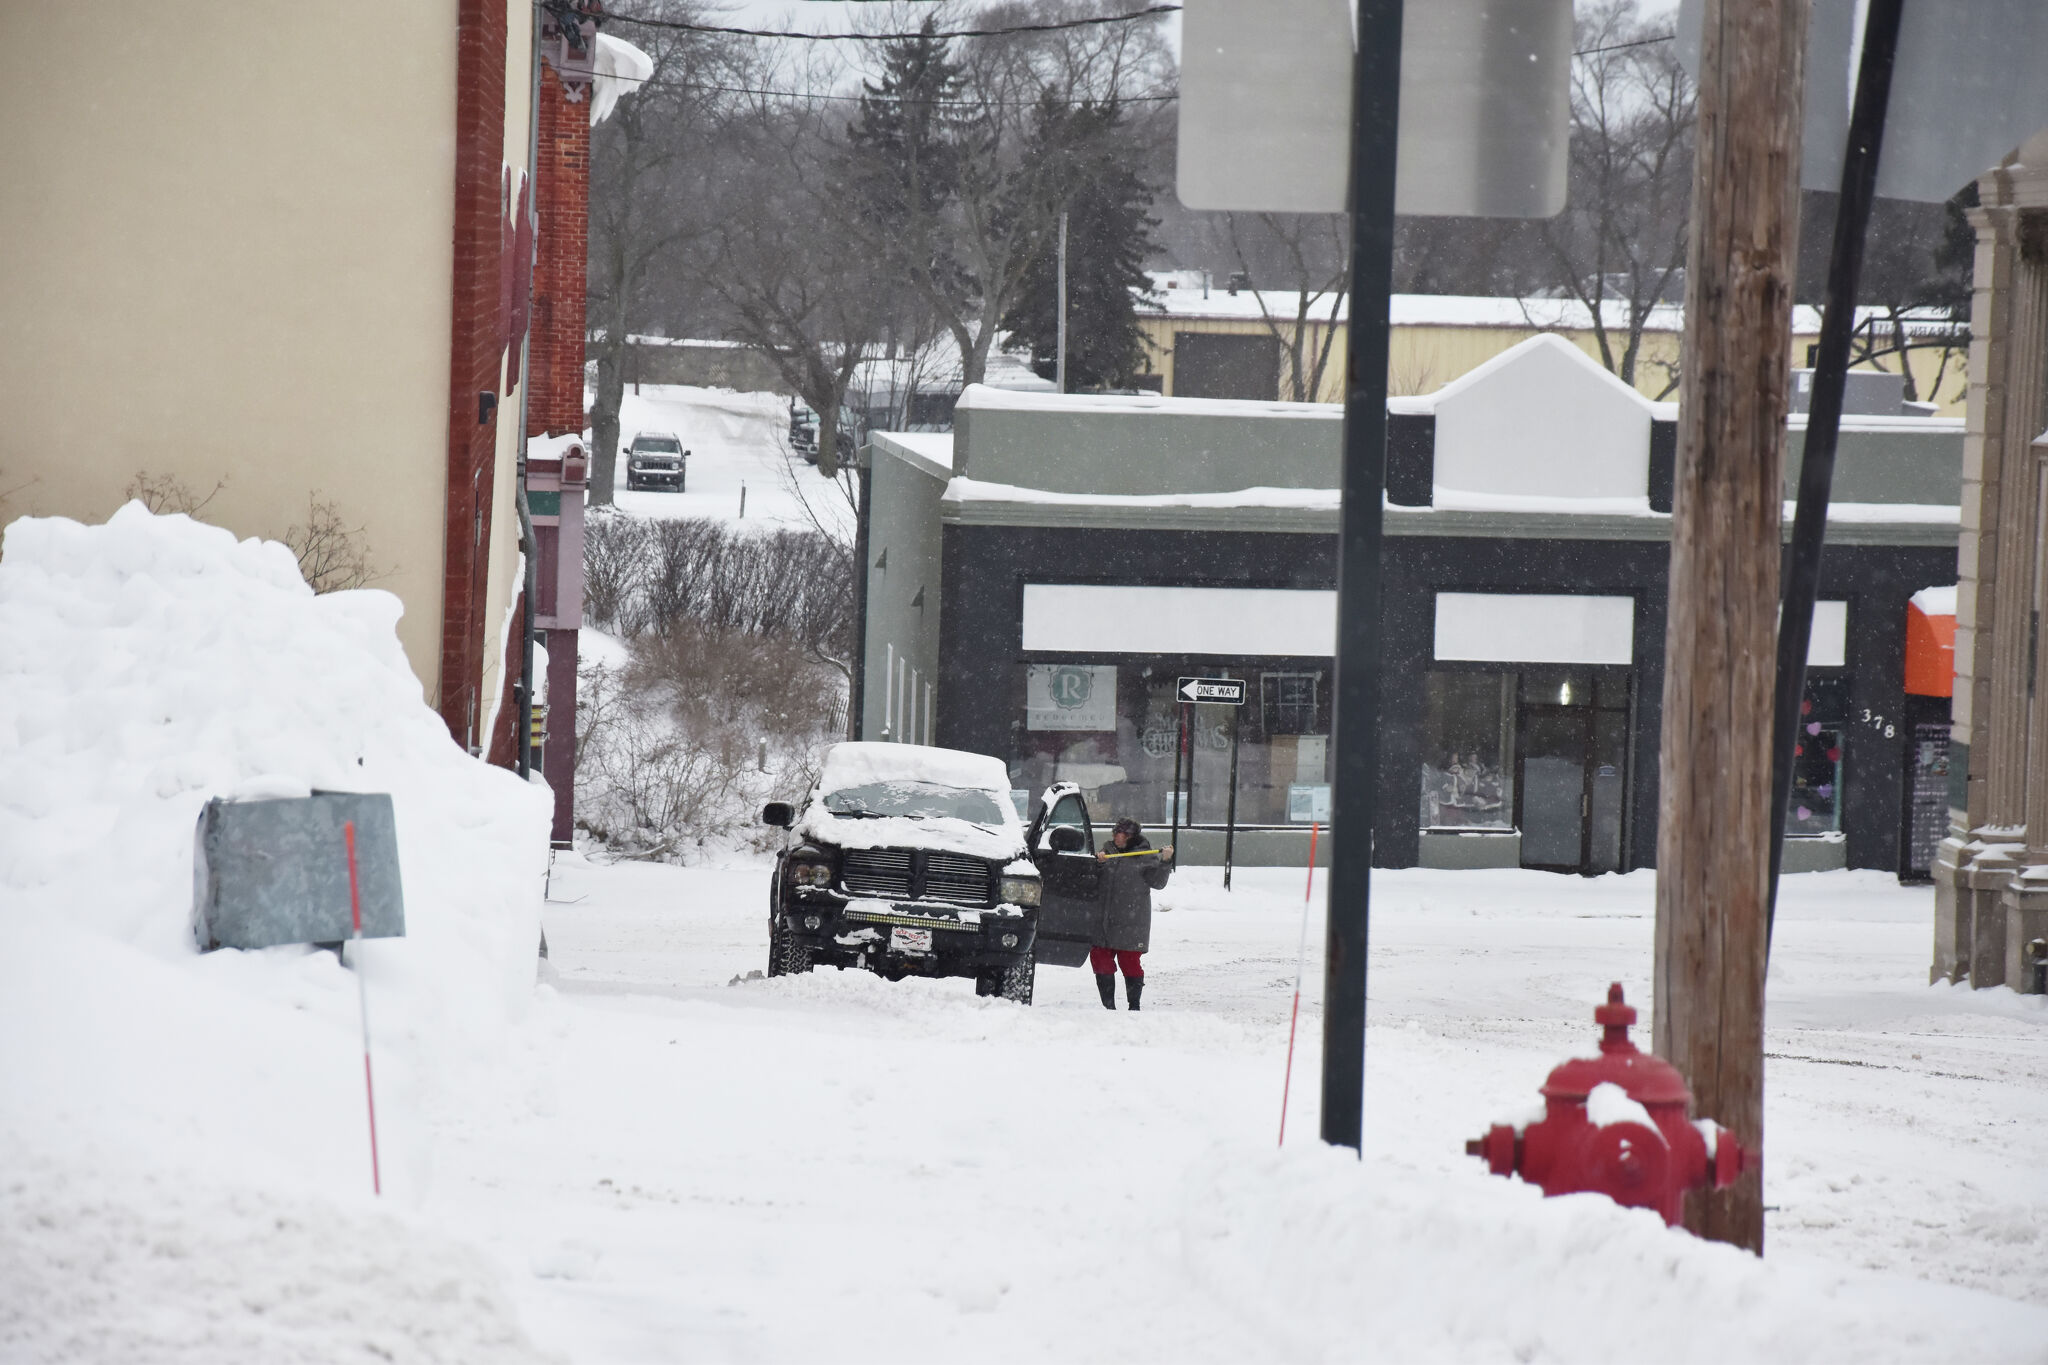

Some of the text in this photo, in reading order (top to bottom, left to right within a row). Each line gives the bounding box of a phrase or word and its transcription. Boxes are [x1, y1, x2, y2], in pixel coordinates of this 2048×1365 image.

[1060, 673, 1081, 699] R
[1196, 686, 1237, 696] ONE WAY
[1861, 708, 1895, 739] 378
